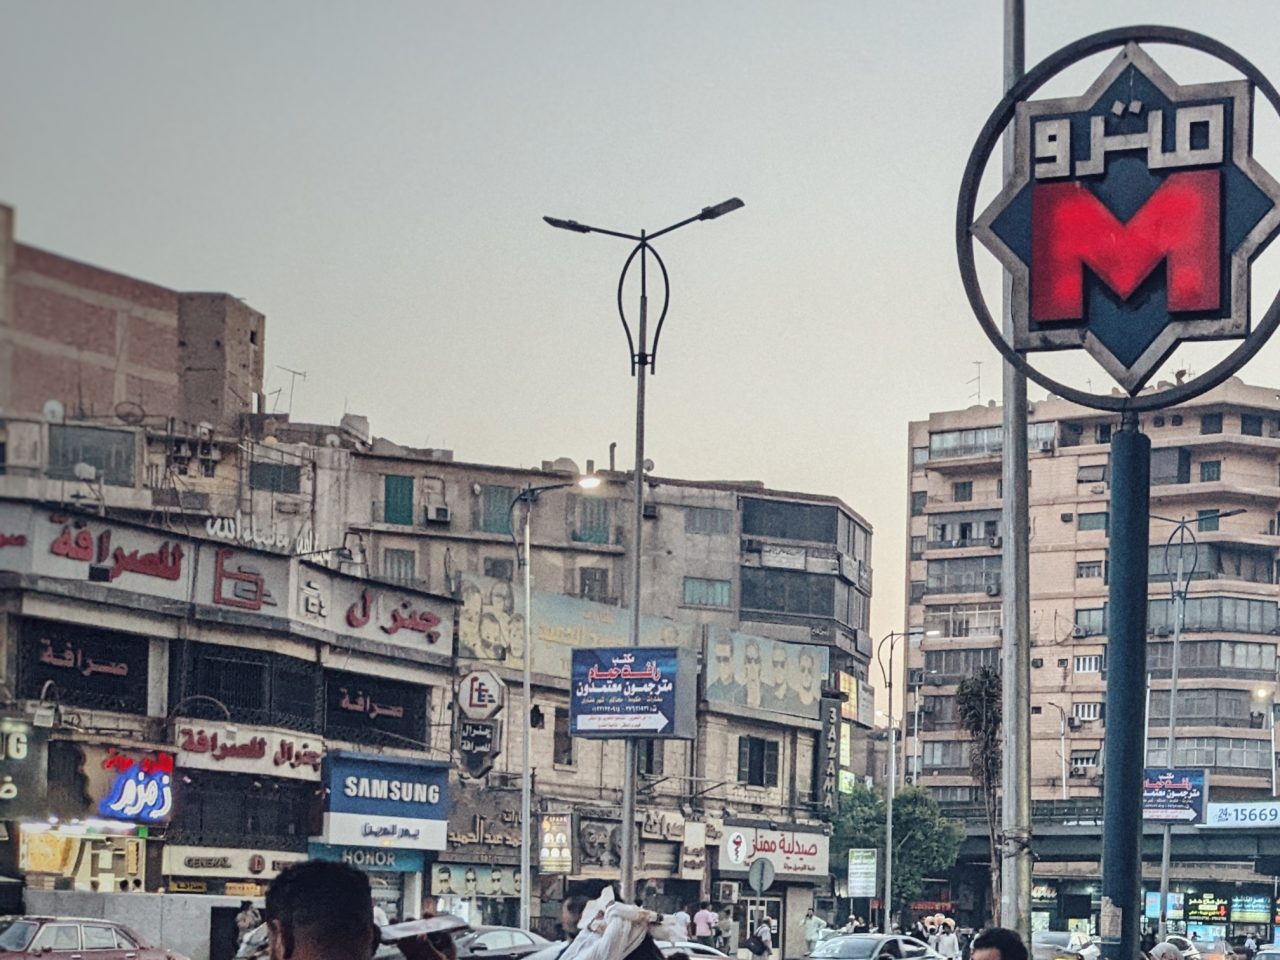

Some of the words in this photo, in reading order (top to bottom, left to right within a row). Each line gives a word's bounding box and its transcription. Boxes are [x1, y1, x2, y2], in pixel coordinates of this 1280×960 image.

[1034, 99, 1225, 180] مترو
[1031, 170, 1221, 321] M
[40, 638, 128, 676] صرافة
[576, 680, 622, 696] معتمدون
[623, 679, 673, 696] مترجمون
[339, 687, 404, 719] صرافة
[181, 728, 267, 761] للصرافة
[110, 771, 173, 819] زمزم
[344, 776, 440, 804] SAMSUNG
[1233, 808, 1278, 821] 15669
[343, 850, 396, 865] HONOR
[778, 832, 818, 861] صيدلية
